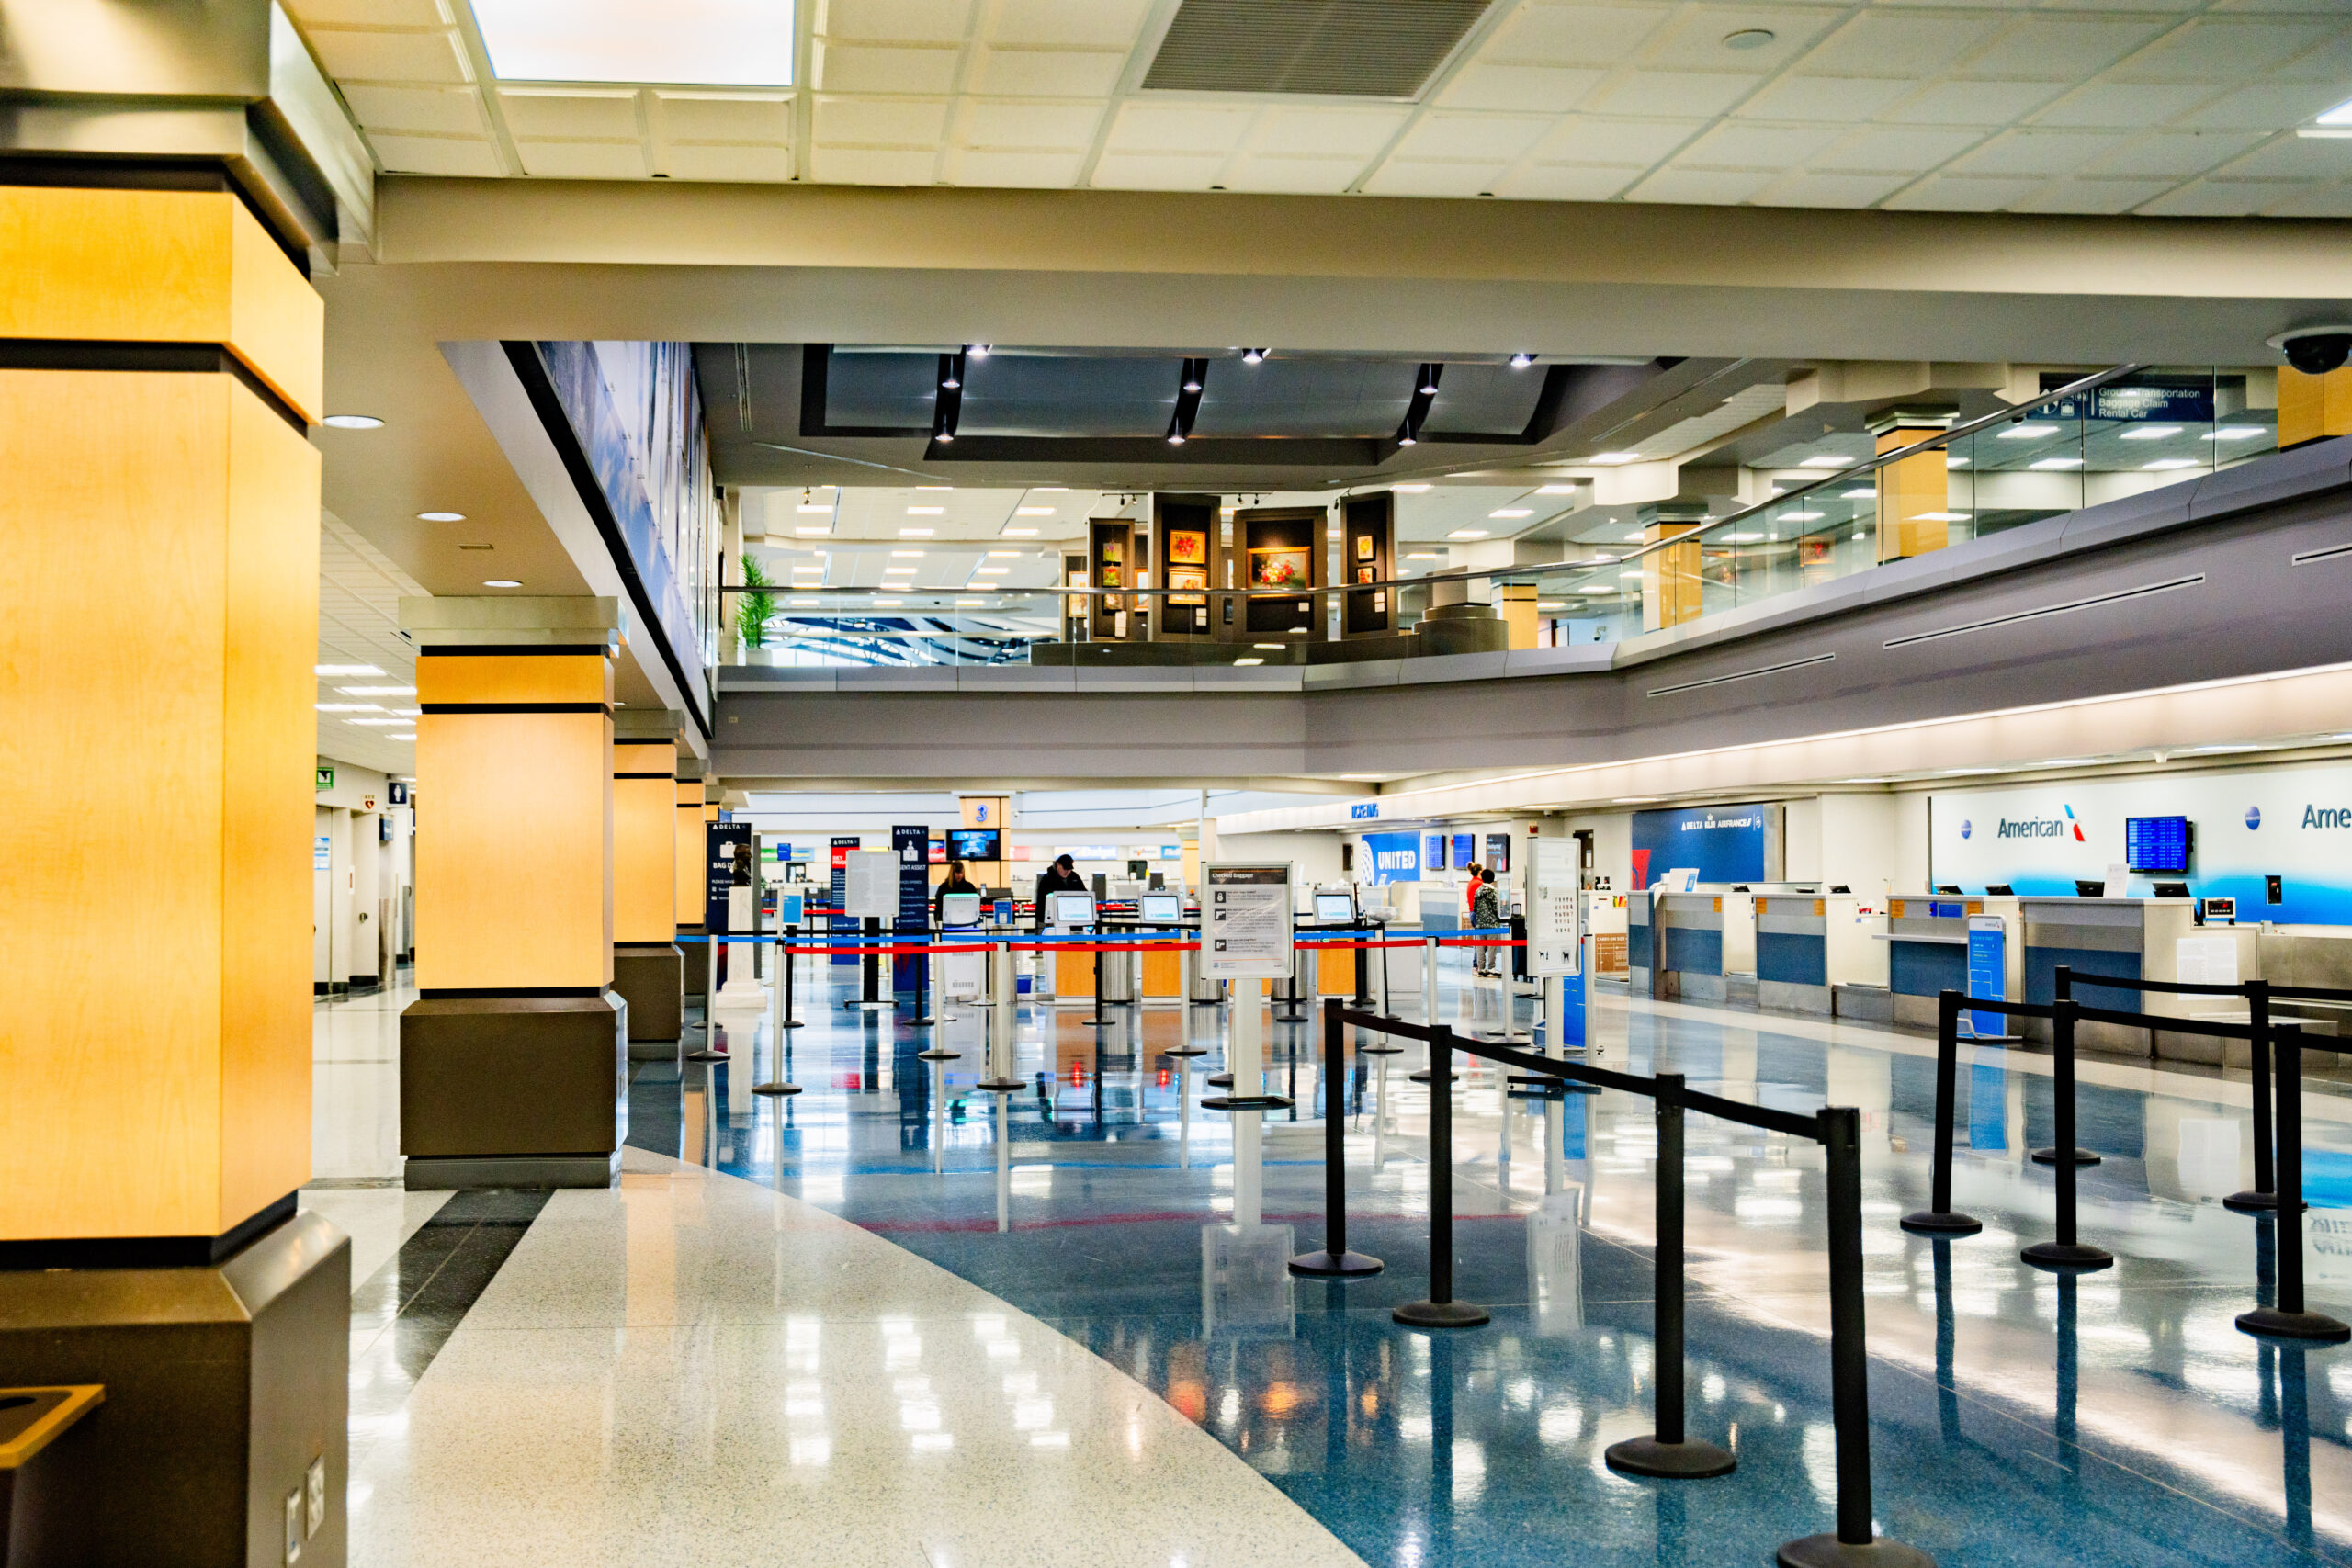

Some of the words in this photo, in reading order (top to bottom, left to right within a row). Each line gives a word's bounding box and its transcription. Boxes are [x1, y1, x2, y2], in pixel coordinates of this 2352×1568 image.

[2098, 388, 2135, 398] Grou
[2136, 388, 2200, 400] Transportation
[2098, 398, 2141, 410] Baggage
[2142, 398, 2169, 409] Claim
[2098, 409, 2129, 418] Rental
[2131, 409, 2149, 419] Car
[975, 804, 988, 822] 3
[2301, 804, 2352, 829] Ame
[1686, 820, 1703, 830] DELTA
[1704, 820, 1716, 829] KLM
[1997, 815, 2064, 839] American
[1378, 850, 1416, 870] UNITED
